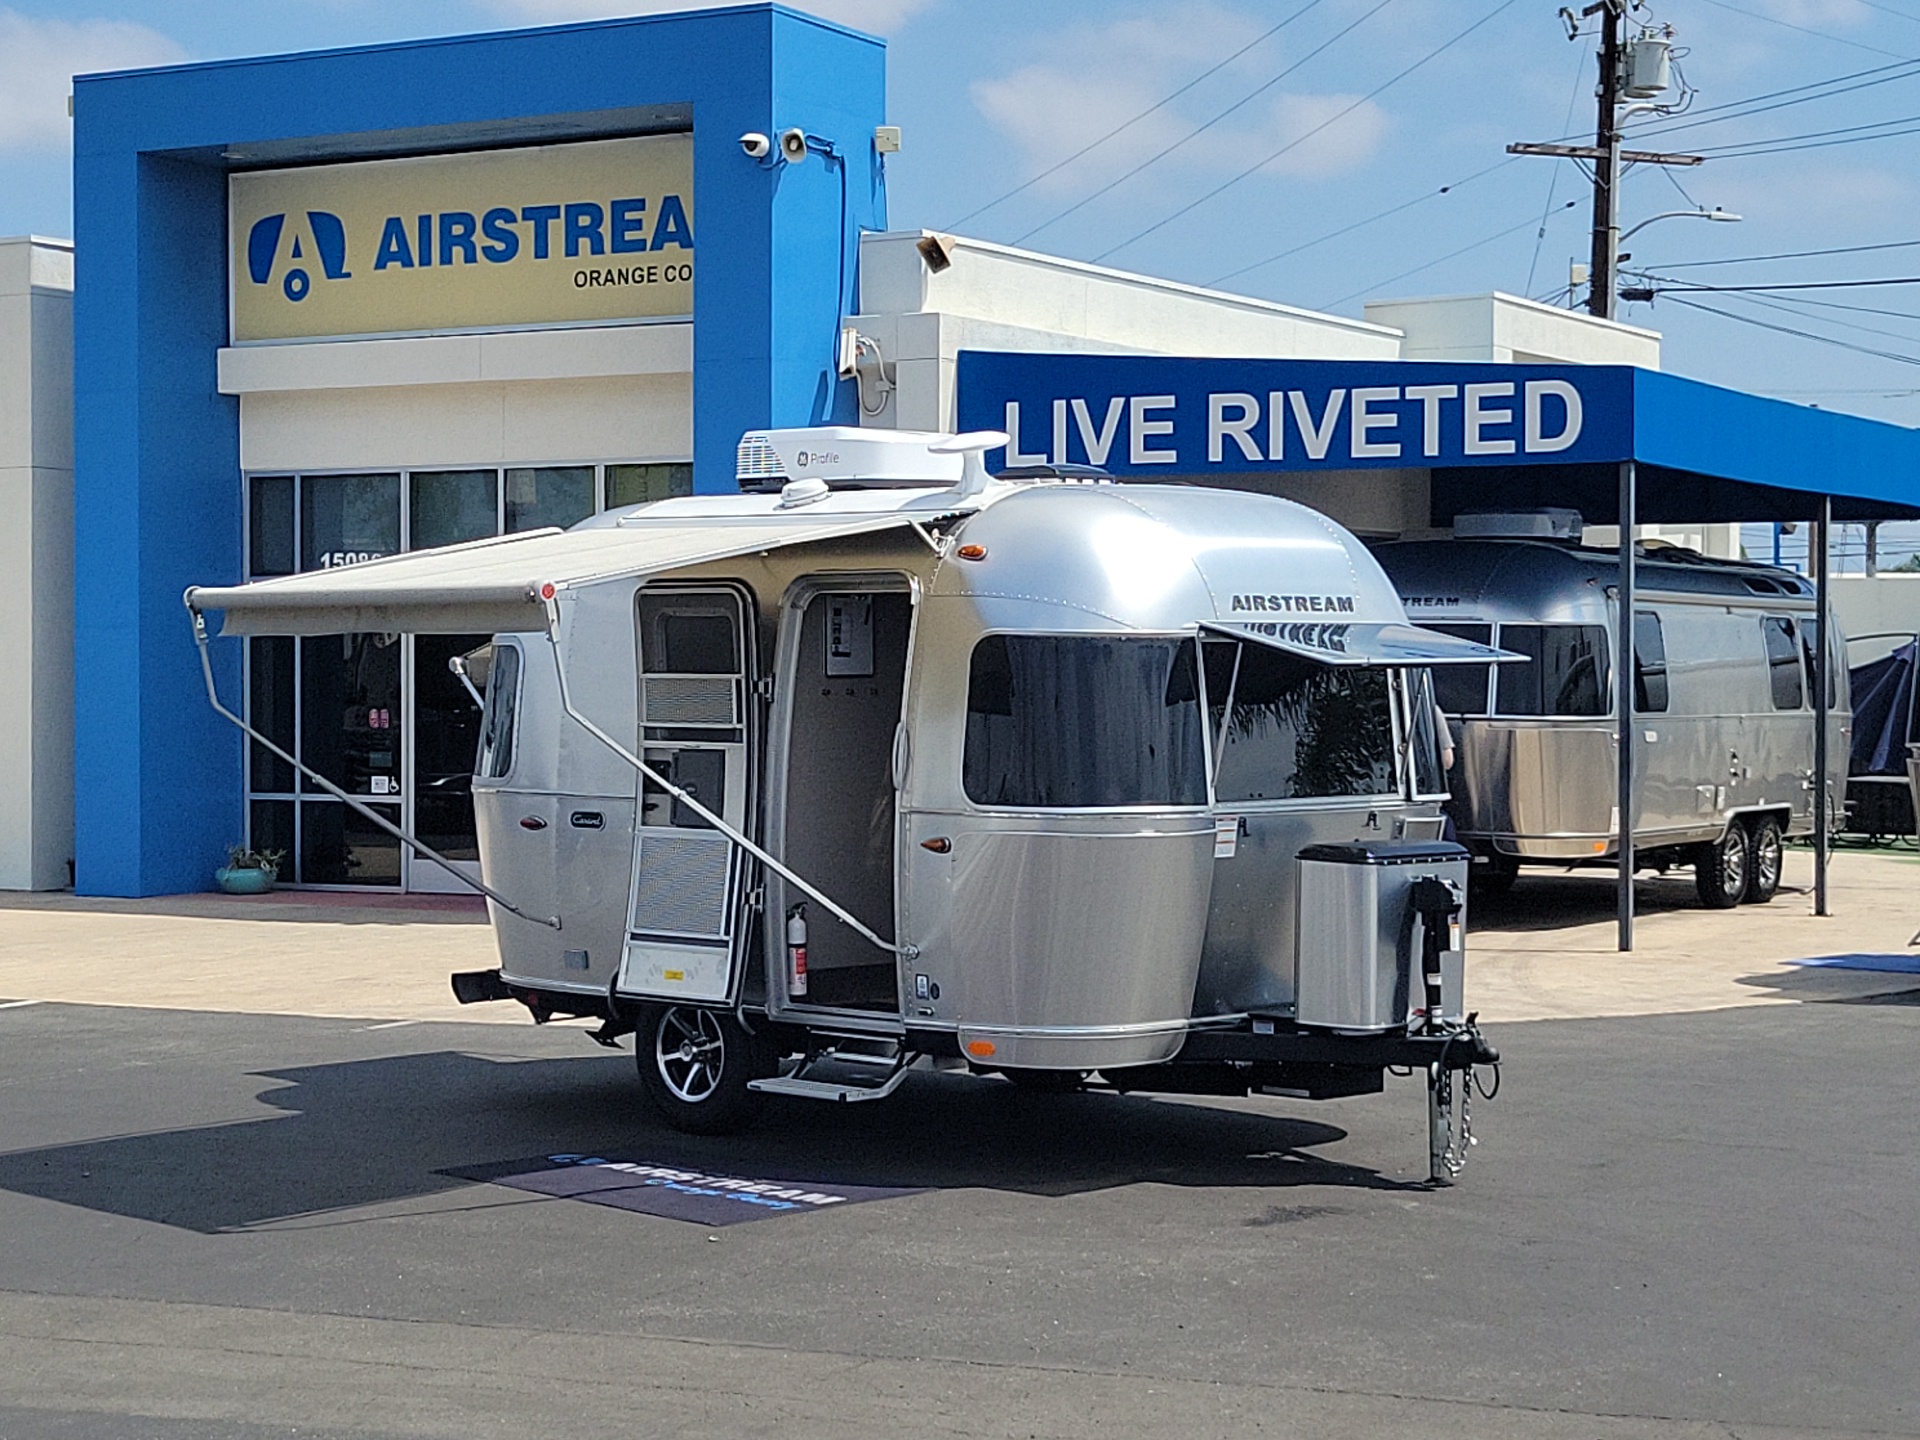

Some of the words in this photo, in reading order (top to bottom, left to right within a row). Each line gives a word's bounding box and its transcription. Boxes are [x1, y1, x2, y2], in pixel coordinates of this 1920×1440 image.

[373, 194, 694, 271] AIRSTREA
[573, 265, 659, 288] ORANGE
[664, 264, 693, 283] CO
[1004, 393, 1178, 468] LIVE
[1207, 379, 1583, 463] RIVETED
[1231, 594, 1355, 613] AIRSTREAM
[1400, 596, 1460, 608] TREAM
[597, 1163, 847, 1204] AIRSTREAM
